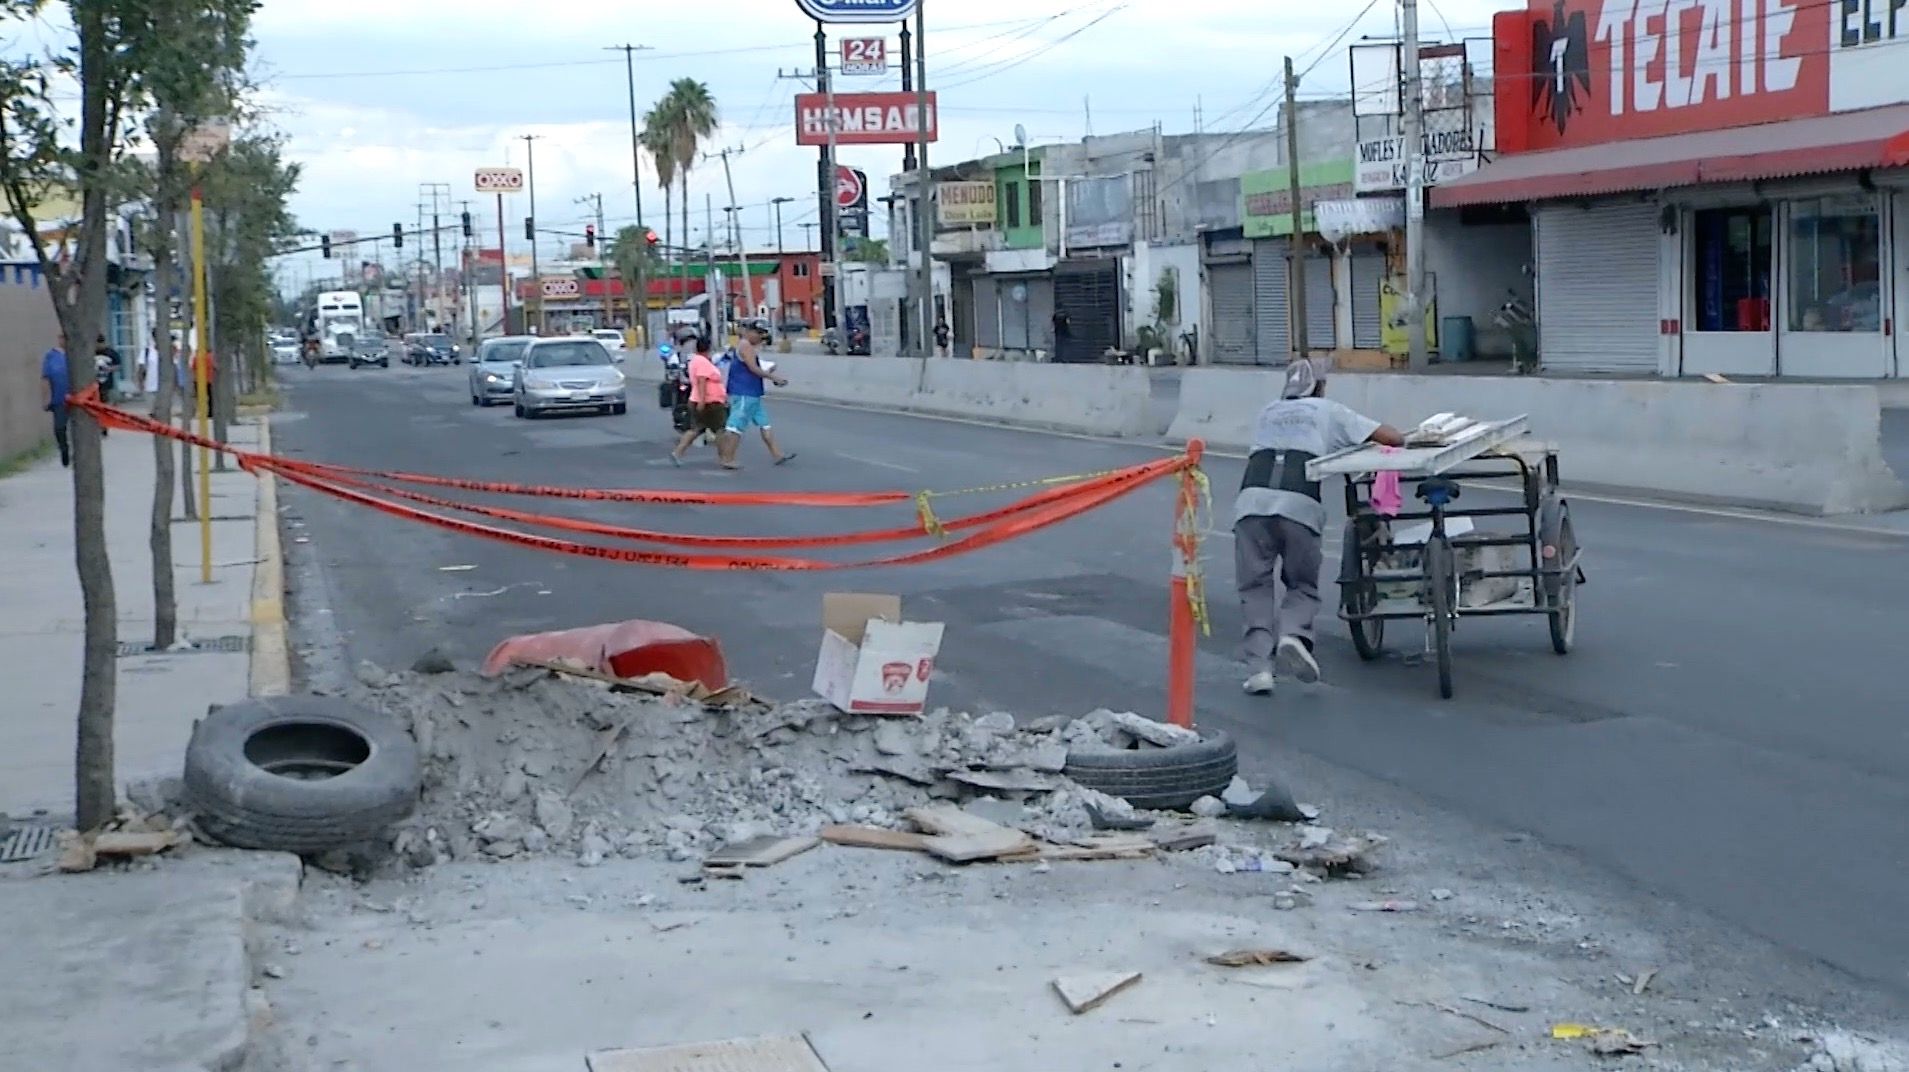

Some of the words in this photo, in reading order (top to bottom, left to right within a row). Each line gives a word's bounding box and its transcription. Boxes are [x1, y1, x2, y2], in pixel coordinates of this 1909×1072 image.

[848, 40, 882, 60] 24
[1594, 0, 1803, 116] TECATE
[1396, 138, 1404, 160] Y
[477, 174, 522, 187] OXXO
[940, 185, 994, 205] MENUDO
[544, 280, 578, 294] OXXO
